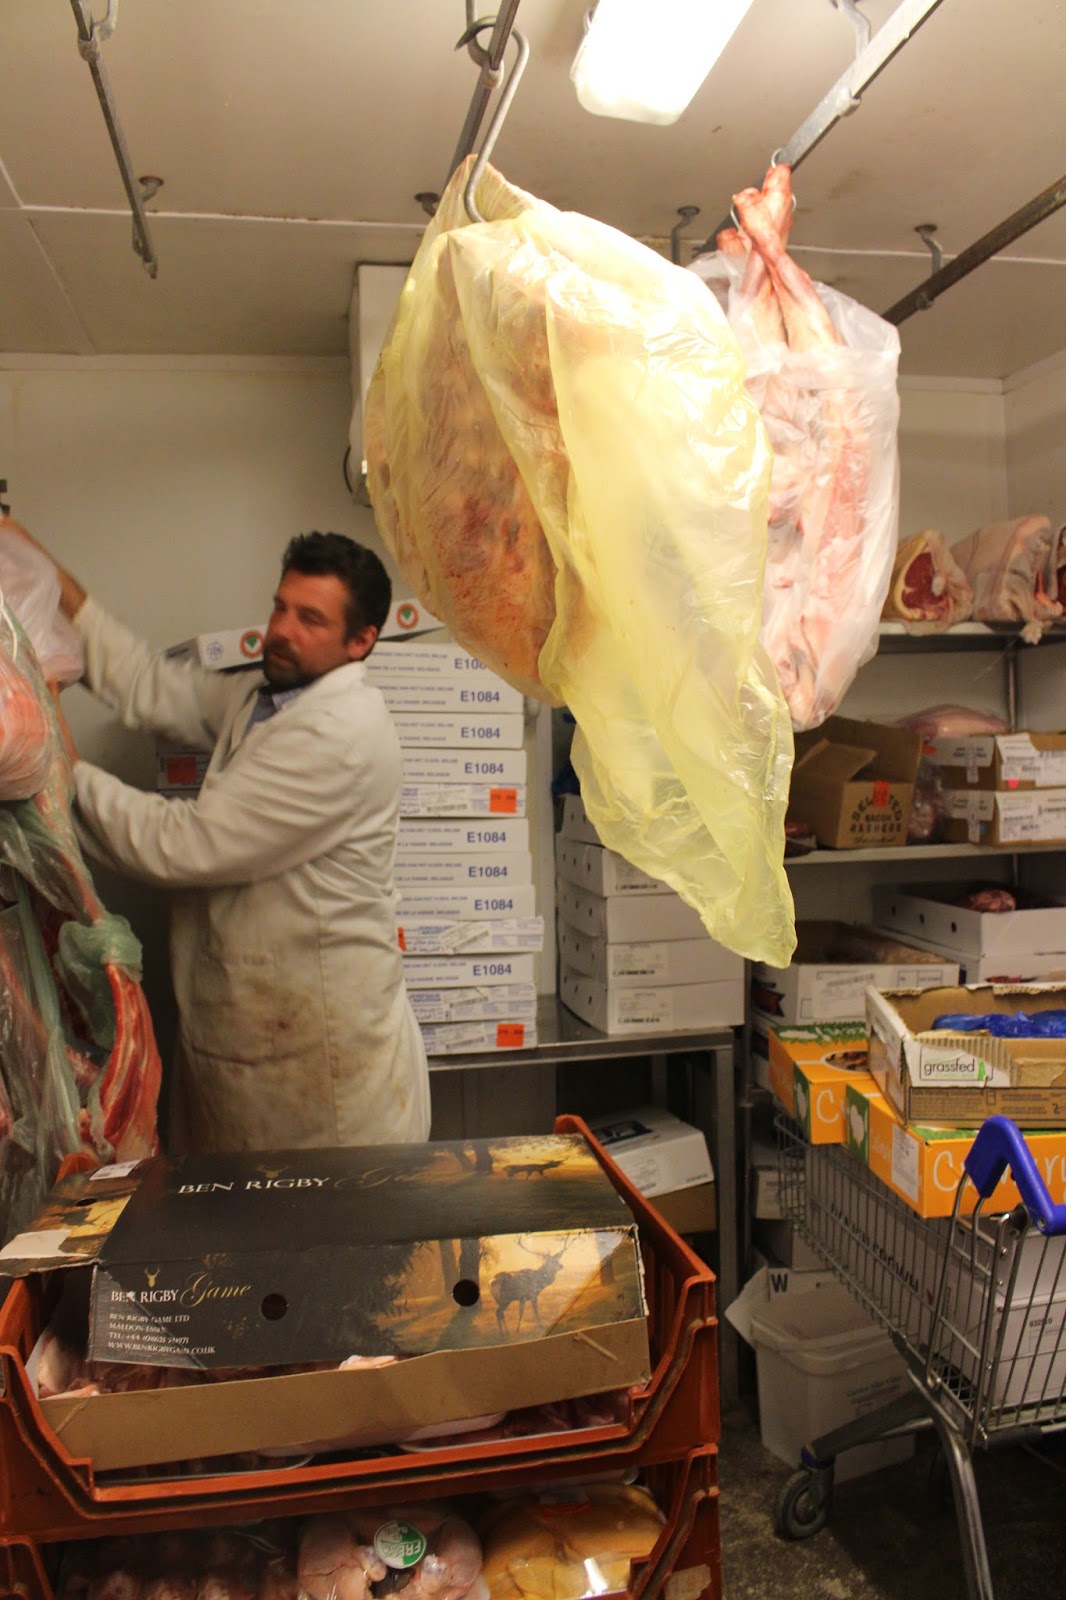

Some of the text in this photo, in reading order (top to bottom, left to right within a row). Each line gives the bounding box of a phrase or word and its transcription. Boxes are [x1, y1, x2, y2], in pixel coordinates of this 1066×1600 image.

[460, 691, 500, 703] E1084
[460, 727, 501, 739] E1084
[464, 763, 504, 774] E1084
[467, 832, 507, 843] E1084
[468, 866, 508, 878] E1084
[474, 899, 513, 911] E1084
[473, 964, 512, 976] E1084
[924, 1058, 976, 1076] grassfed
[178, 1177, 330, 1194] BEN RIGBY
[770, 1273, 788, 1293] W
[111, 1271, 251, 1308] BEN RIGBY Game
[175, 1314, 190, 1322] LTD
